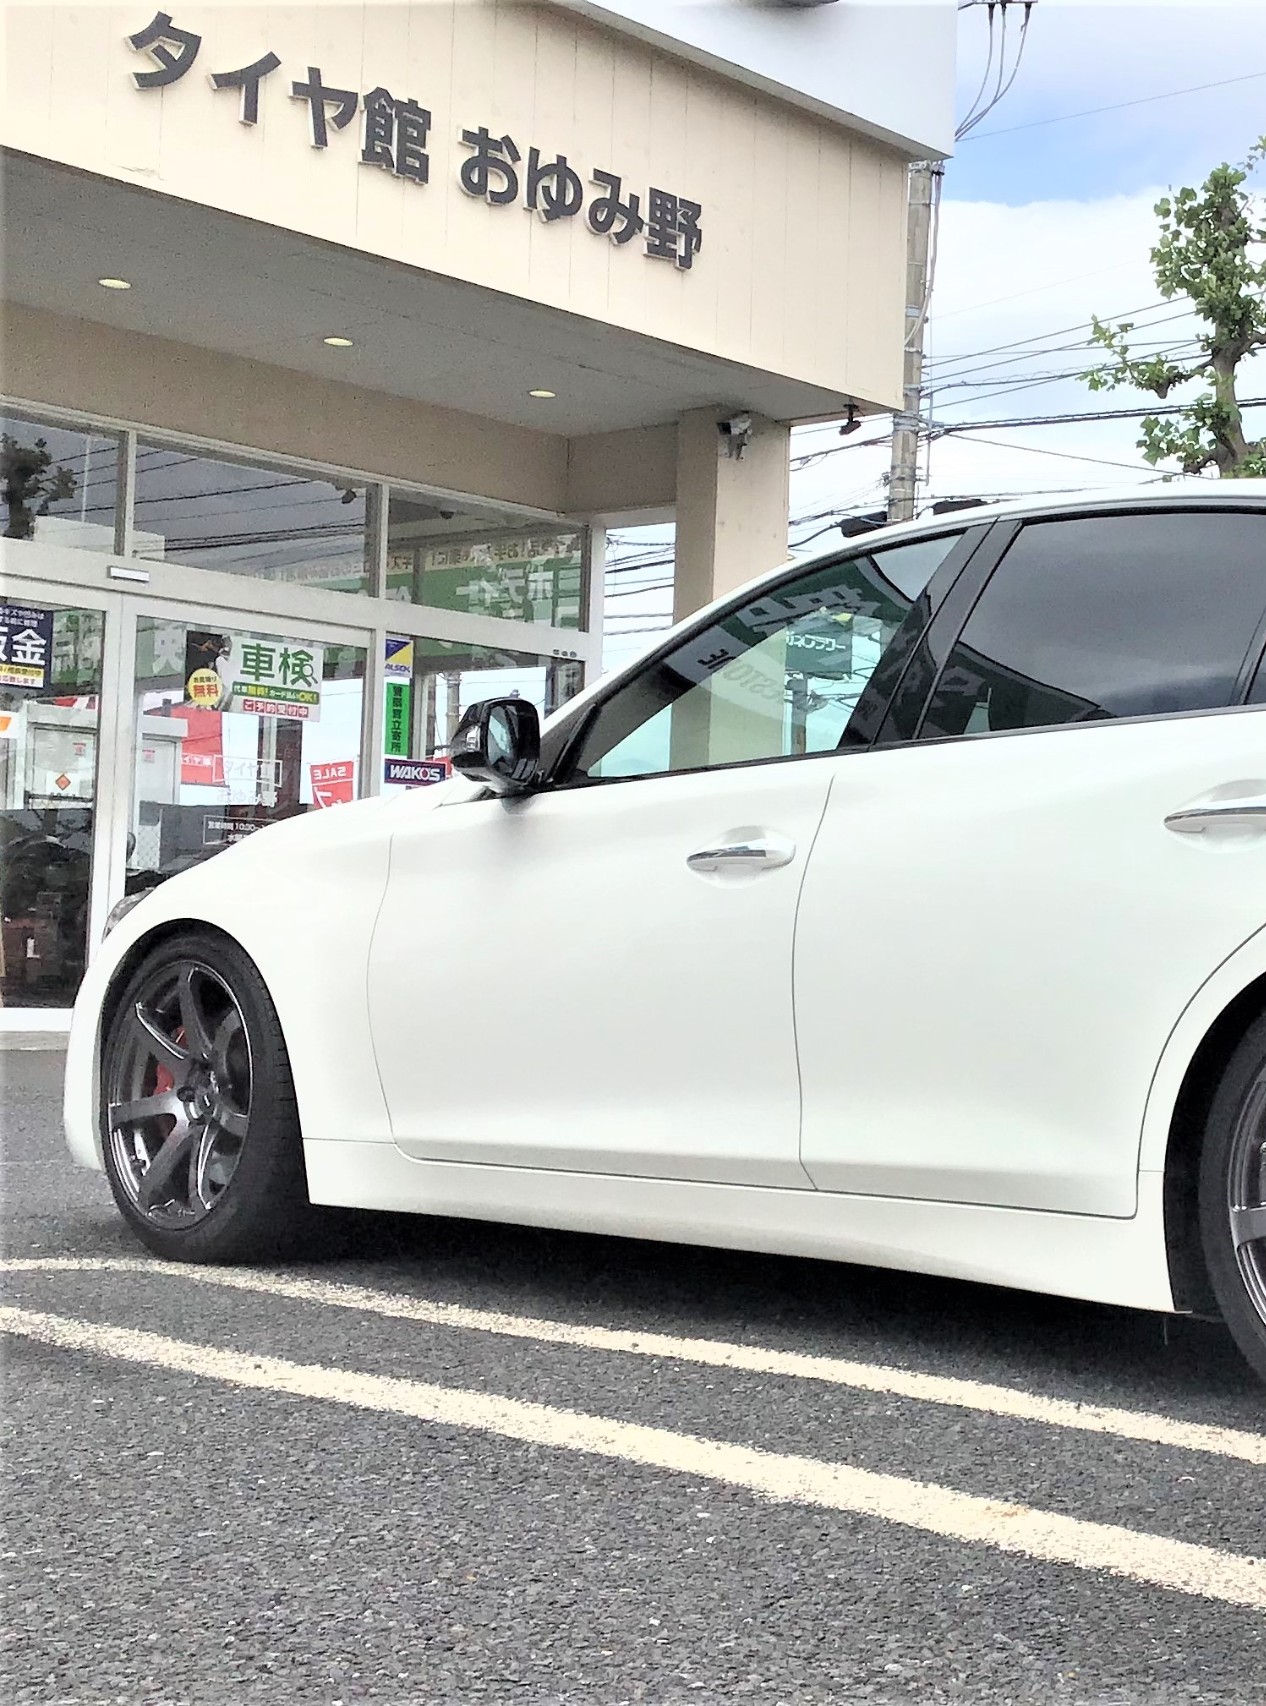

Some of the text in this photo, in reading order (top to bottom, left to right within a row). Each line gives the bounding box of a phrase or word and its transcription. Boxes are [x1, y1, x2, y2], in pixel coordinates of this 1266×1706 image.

[125, 11, 703, 270] タイヤ館 おゆみ野
[0, 626, 47, 665] 金
[240, 643, 318, 687] 車検
[193, 684, 218, 698] 無料
[244, 700, 309, 718] ご予約受付中
